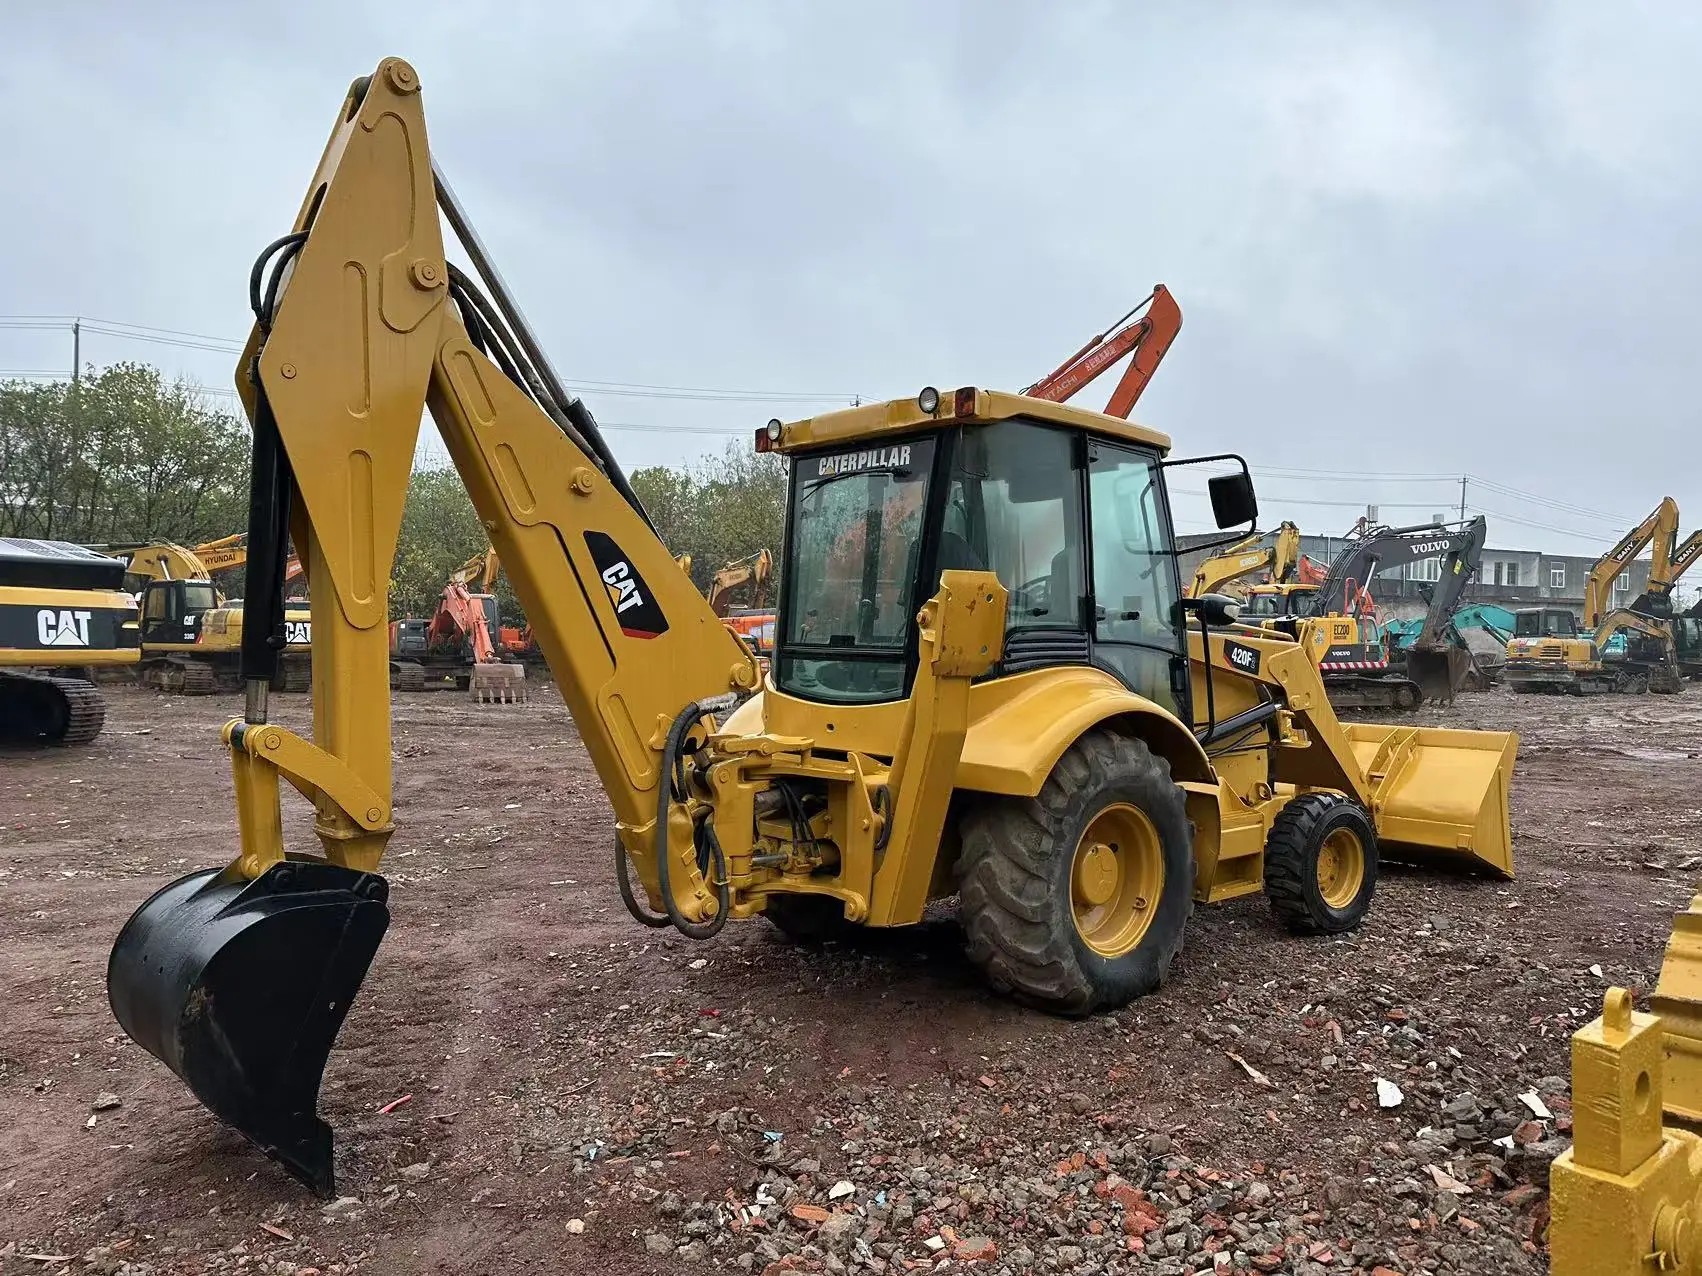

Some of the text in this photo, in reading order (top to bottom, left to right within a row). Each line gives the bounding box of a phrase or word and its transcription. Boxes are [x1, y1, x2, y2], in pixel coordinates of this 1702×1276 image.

[818, 446, 911, 476] CATERPILLAR
[1410, 540, 1450, 554] VOLVO
[1617, 542, 1634, 561] SANY
[1678, 545, 1696, 563] SANY
[205, 553, 236, 565] HYUNDAI
[603, 561, 644, 613] CAT
[37, 609, 92, 646] CAT
[184, 615, 196, 626] CAT
